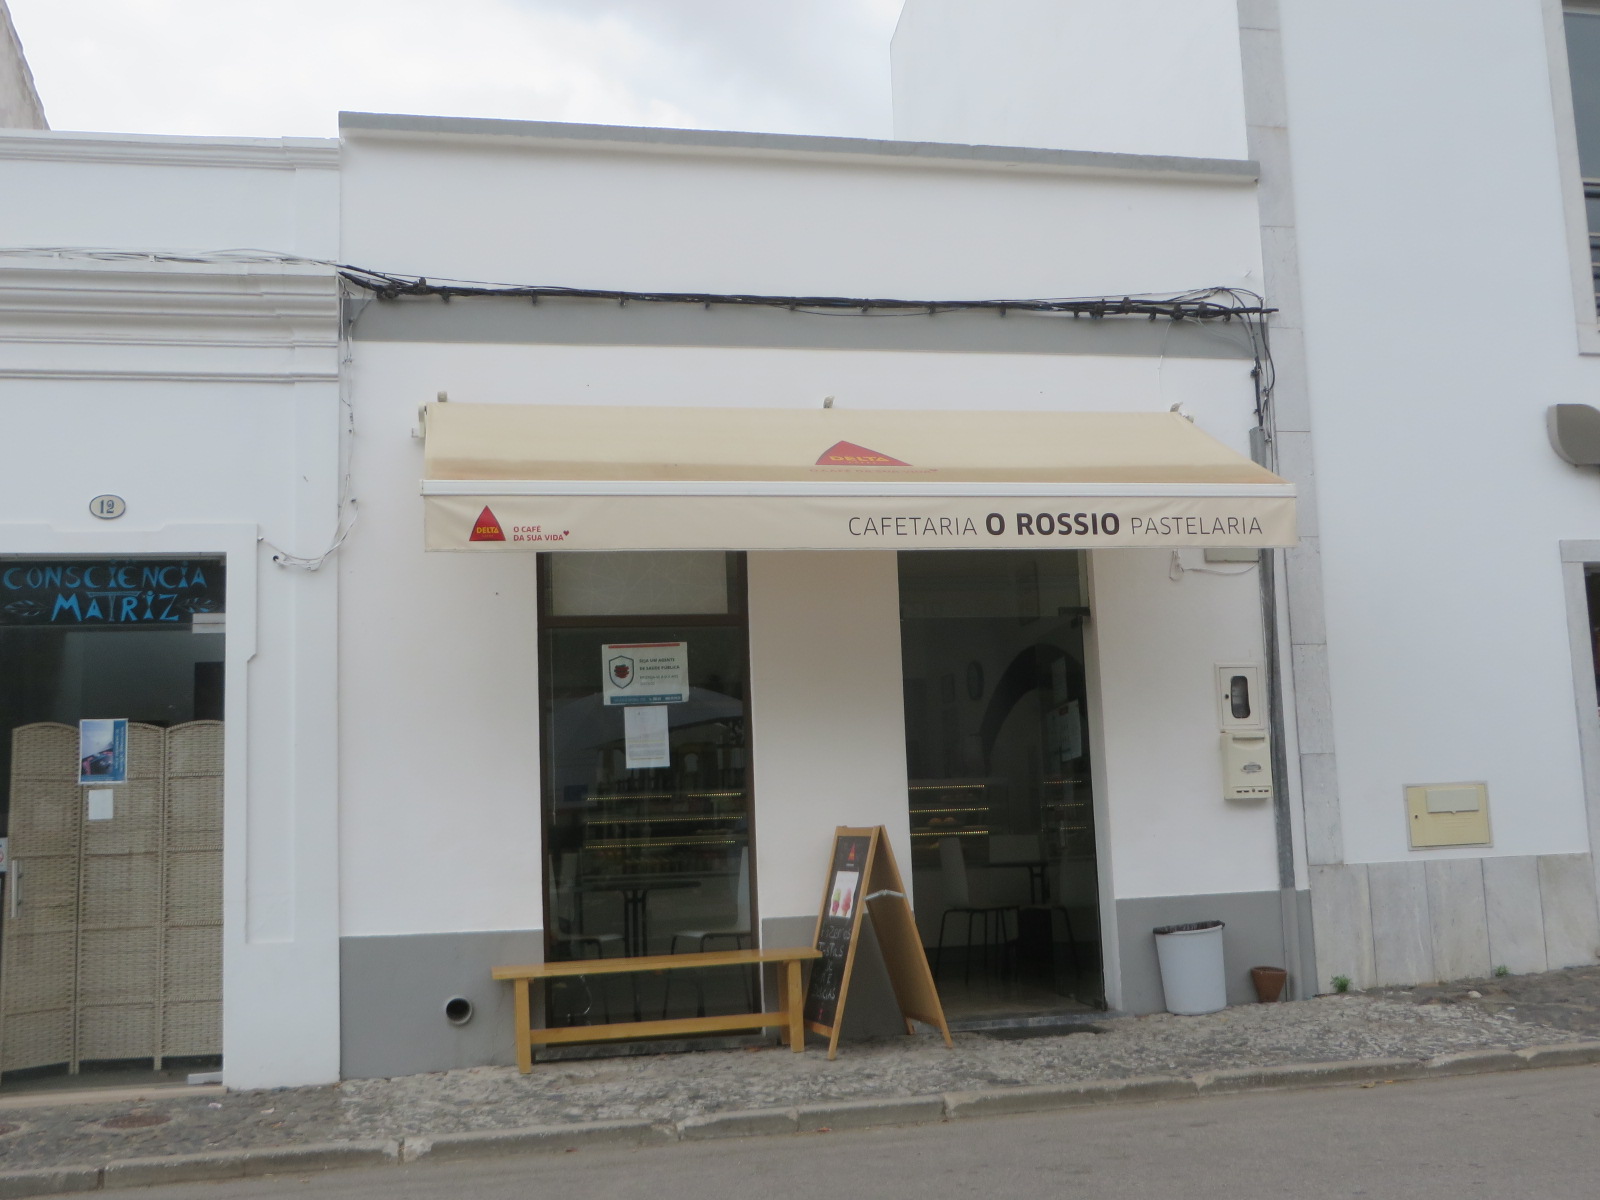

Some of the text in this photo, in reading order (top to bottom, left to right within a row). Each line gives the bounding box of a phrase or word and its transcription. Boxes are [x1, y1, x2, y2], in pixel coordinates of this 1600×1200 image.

[99, 499, 115, 514] 12
[476, 526, 499, 534] DELTA
[521, 525, 541, 533] CAFÉ
[848, 511, 1263, 536] CAFETARIA O ROSSIO PASTELARIA
[51, 590, 179, 622] MATRIZ
